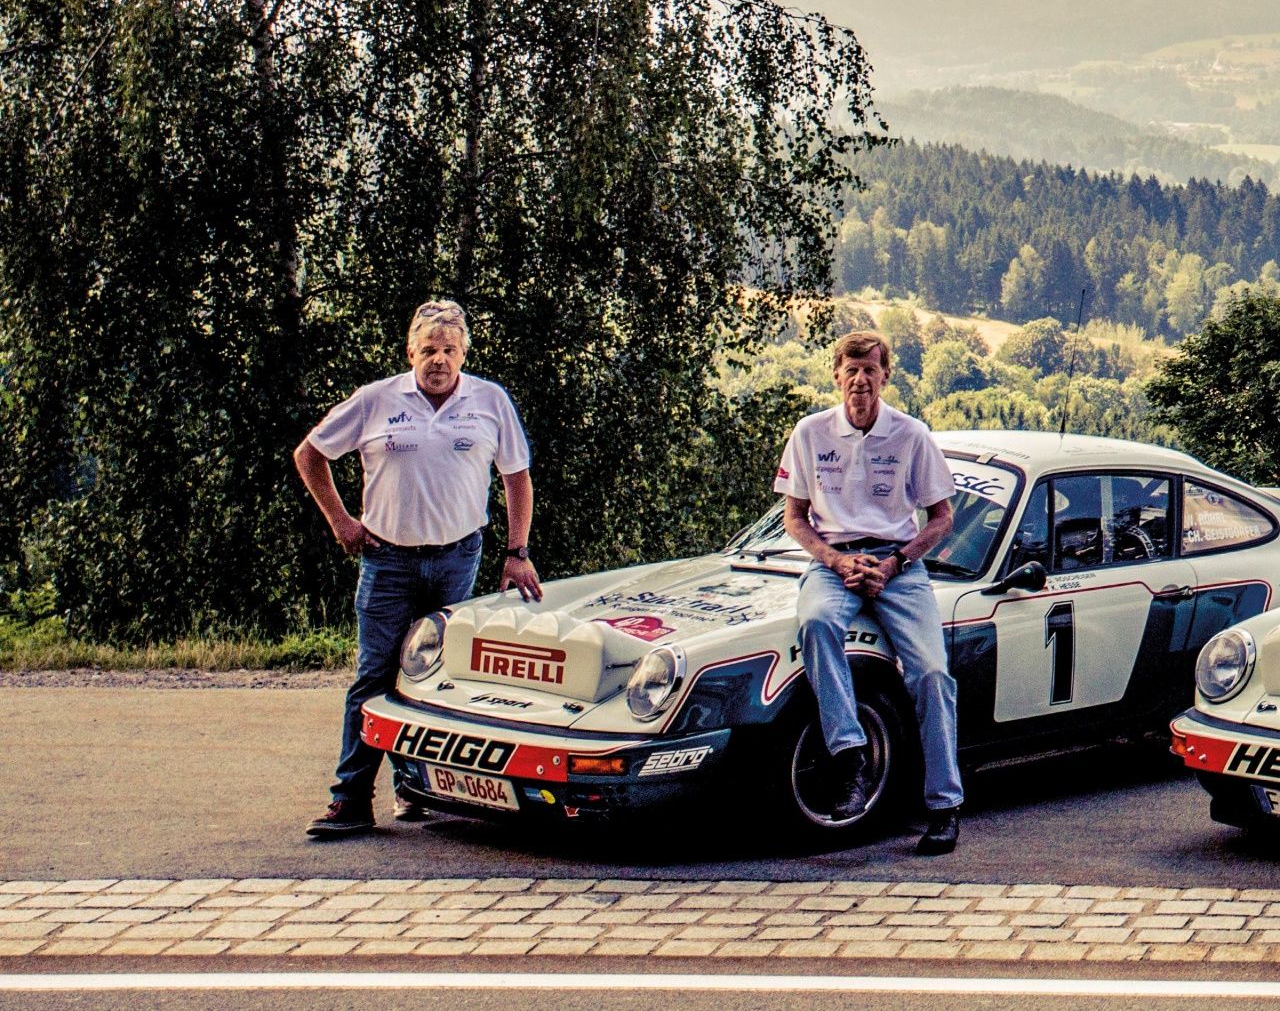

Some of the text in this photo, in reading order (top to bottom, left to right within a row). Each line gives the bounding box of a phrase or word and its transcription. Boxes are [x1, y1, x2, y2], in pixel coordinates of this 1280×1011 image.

[388, 412, 412, 424] wfv
[818, 450, 841, 462] wfv
[470, 637, 566, 684] PIRELLI
[1045, 600, 1075, 706] 1
[394, 723, 516, 771] HEIGO
